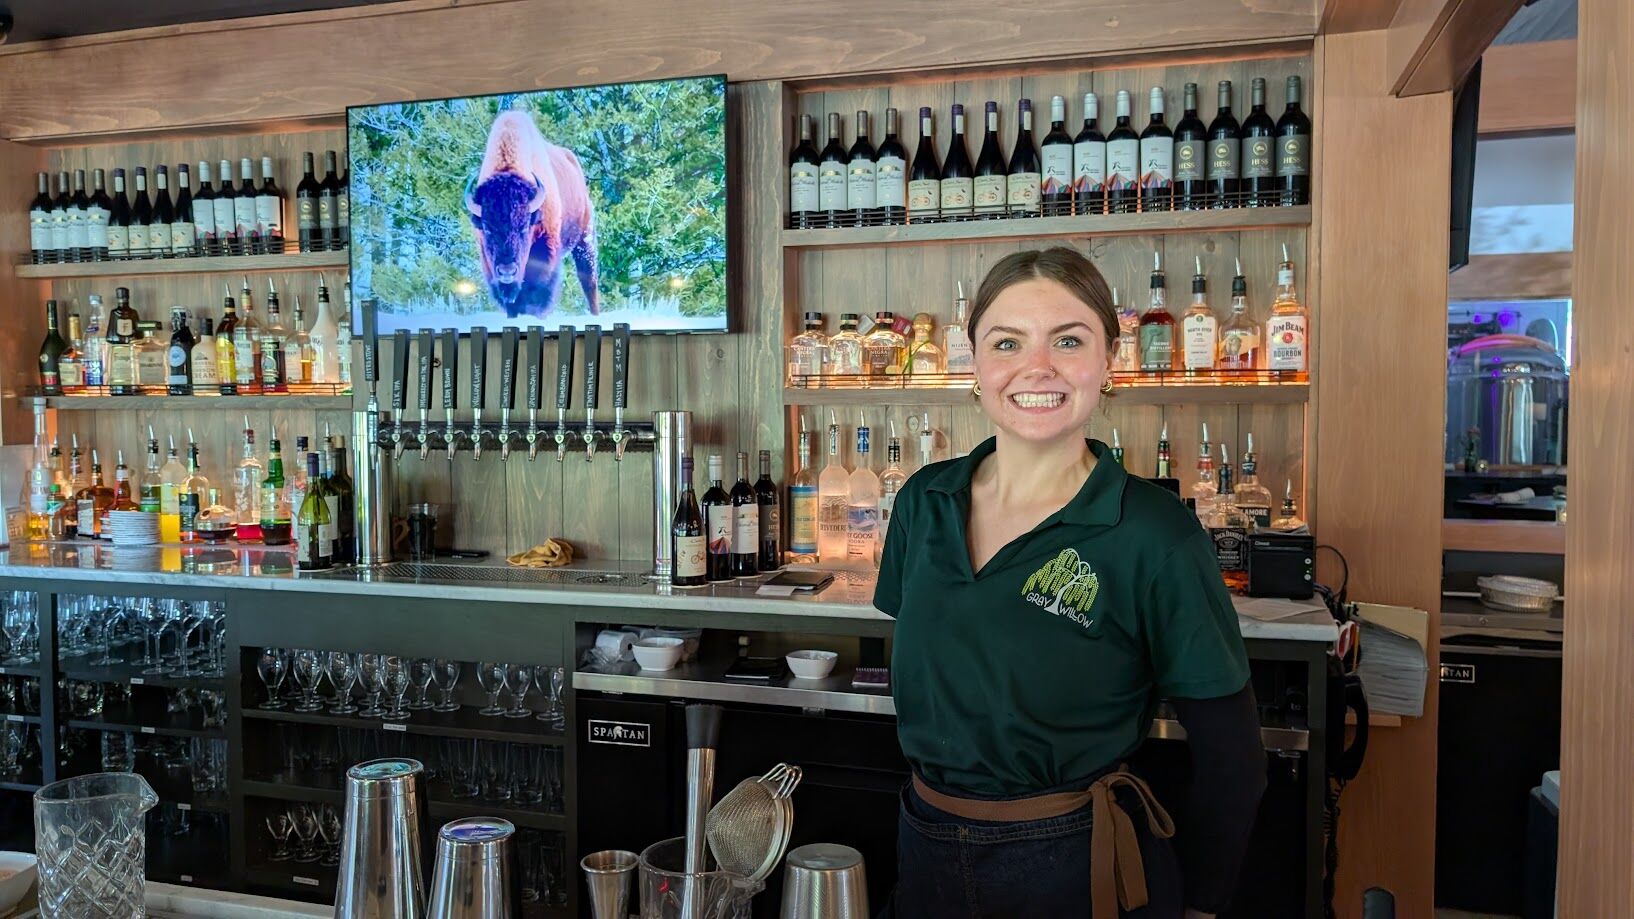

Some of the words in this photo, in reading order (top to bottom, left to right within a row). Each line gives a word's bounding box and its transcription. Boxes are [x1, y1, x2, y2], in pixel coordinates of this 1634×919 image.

[1252, 158, 1268, 166] HESS
[1271, 324, 1284, 336] JIM
[1285, 321, 1304, 335] BEAM
[1273, 350, 1302, 358] BOURBON
[1026, 592, 1052, 607] GRAY
[1059, 603, 1094, 629] WILLOW
[593, 726, 645, 740] SPARTAN
